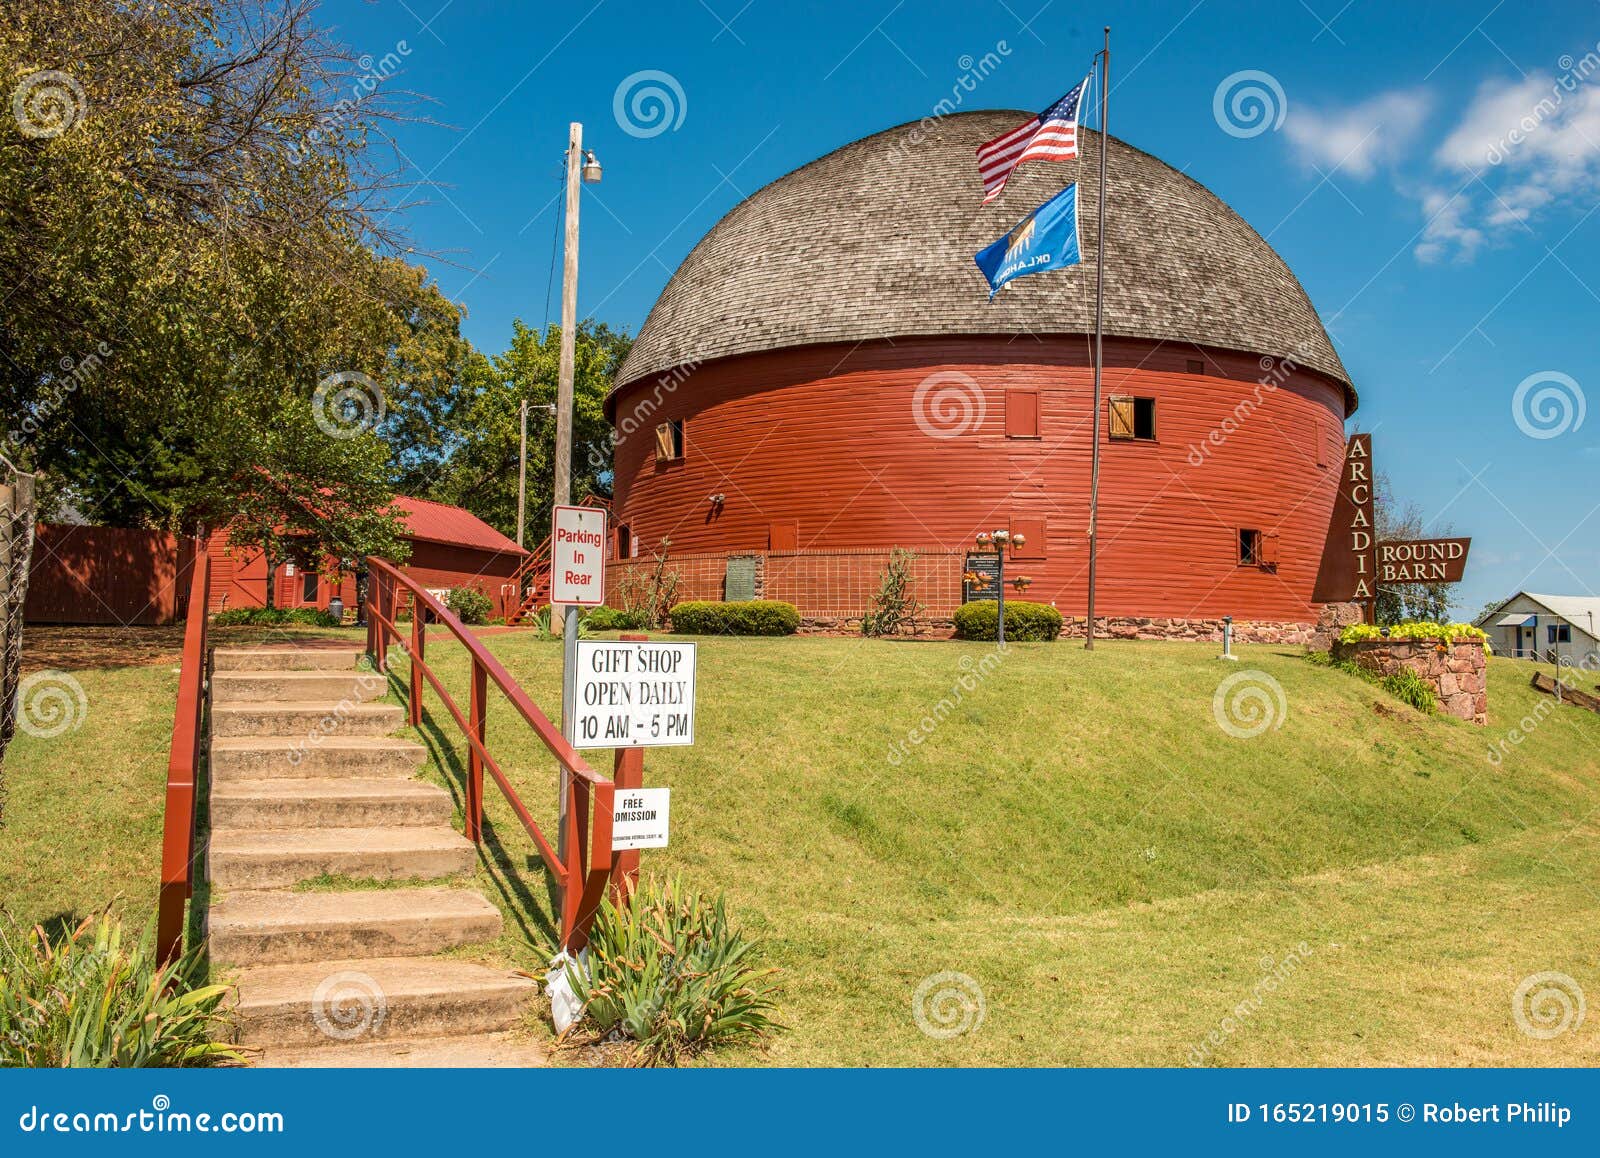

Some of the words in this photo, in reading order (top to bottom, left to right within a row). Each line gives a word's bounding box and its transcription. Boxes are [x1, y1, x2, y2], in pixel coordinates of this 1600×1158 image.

[1349, 439, 1372, 598] ARCADIA
[557, 528, 601, 547] Parking
[573, 550, 584, 564] In
[1382, 542, 1463, 562] ROUND
[565, 571, 592, 585] Rear
[1383, 563, 1447, 582] BARN
[592, 649, 632, 673] GIFT
[637, 649, 682, 673] SHOP
[584, 681, 632, 705] OPEN
[639, 681, 686, 705] DAILY
[580, 715, 598, 739] 10
[604, 715, 630, 738] AM
[650, 713, 660, 737] 5
[666, 713, 688, 736] PM
[623, 798, 643, 809] FREE
[612, 810, 657, 823] DMISSION
